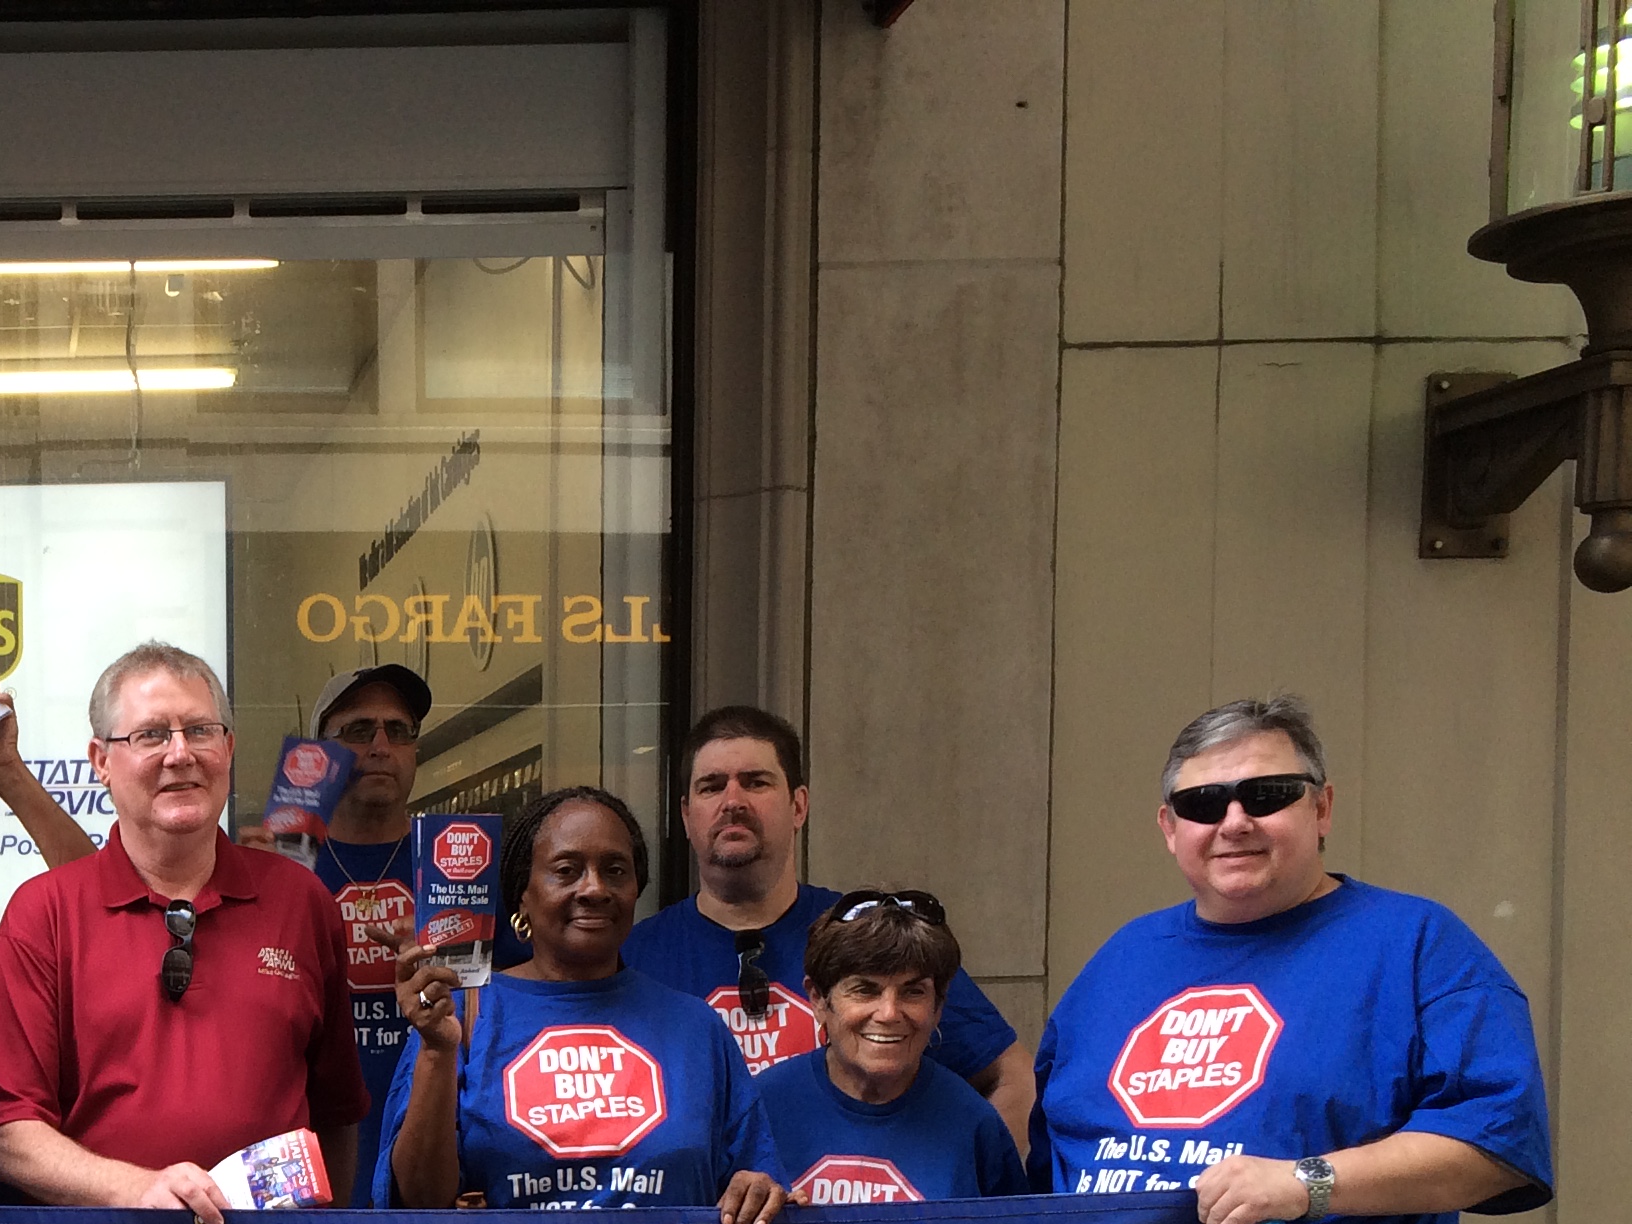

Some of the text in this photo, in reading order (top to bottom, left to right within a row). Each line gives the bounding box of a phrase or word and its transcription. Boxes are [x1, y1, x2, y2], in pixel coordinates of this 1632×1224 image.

[446, 831, 480, 845] DON'T
[451, 843, 474, 857] BUY
[439, 855, 483, 868] STAPLES
[428, 894, 489, 905] Is NOT for Sale
[430, 883, 488, 895] The U.S. Mail
[353, 1001, 390, 1020] U.S.
[1159, 1005, 1255, 1036] DON'T
[376, 1027, 401, 1046] for
[1161, 1035, 1229, 1064] BUY
[538, 1046, 625, 1074] DON'T
[554, 1073, 616, 1099] BUY
[1127, 1061, 1242, 1096] STAPLES
[528, 1096, 646, 1127] STAPLES
[1094, 1136, 1127, 1162] The
[1128, 1135, 1172, 1163] U.S.
[507, 1166, 664, 1198] The U.S. Mail
[811, 1178, 900, 1204] DON'T
[1076, 1170, 1093, 1194] Is
[1095, 1169, 1141, 1193] NOT
